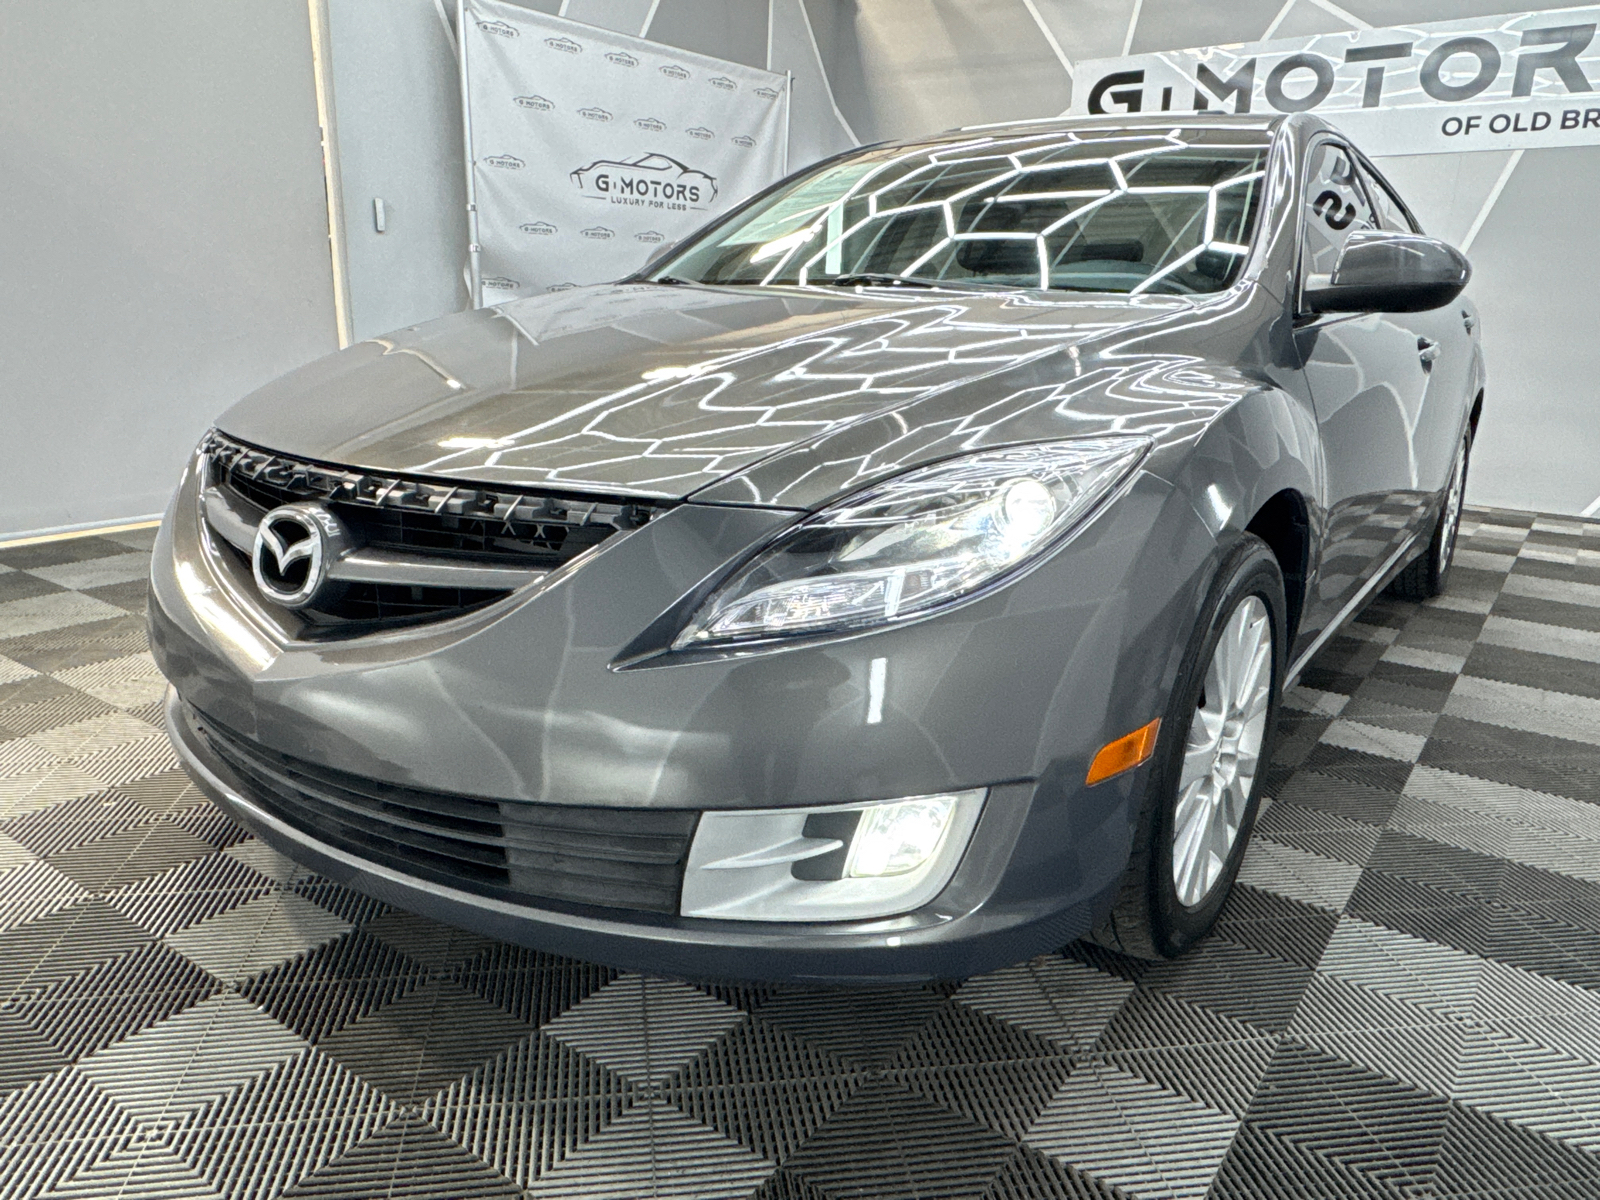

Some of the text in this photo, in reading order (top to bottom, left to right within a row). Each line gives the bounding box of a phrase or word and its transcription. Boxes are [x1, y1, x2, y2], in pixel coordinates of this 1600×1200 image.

[526, 101, 550, 110] MOTORS
[1441, 115, 1482, 136] OF
[1489, 112, 1552, 134] OLD
[596, 174, 700, 202] G MOTORS
[611, 196, 686, 211] LUXURY FOR LESS
